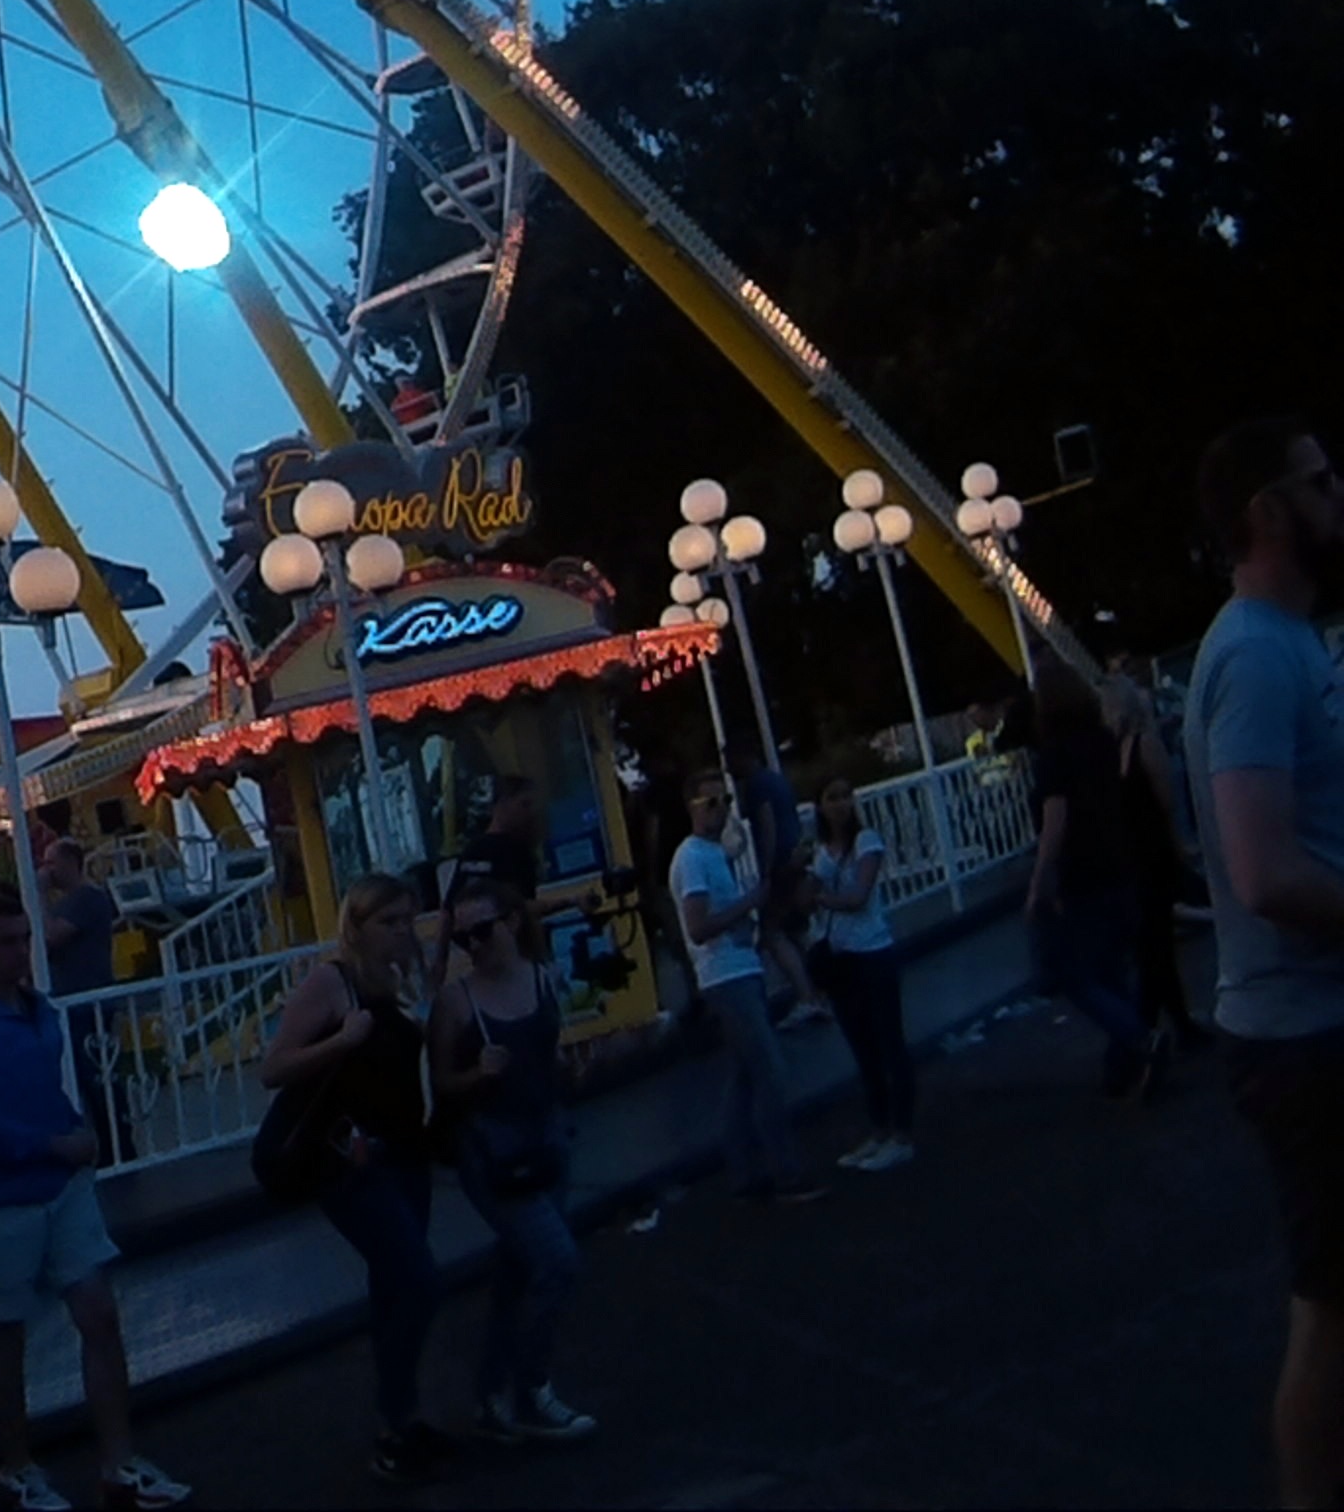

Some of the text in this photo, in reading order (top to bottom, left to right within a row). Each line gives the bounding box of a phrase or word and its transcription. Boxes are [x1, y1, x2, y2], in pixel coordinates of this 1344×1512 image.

[261, 447, 533, 543] Eopa Rad
[355, 598, 520, 659] Kasse
